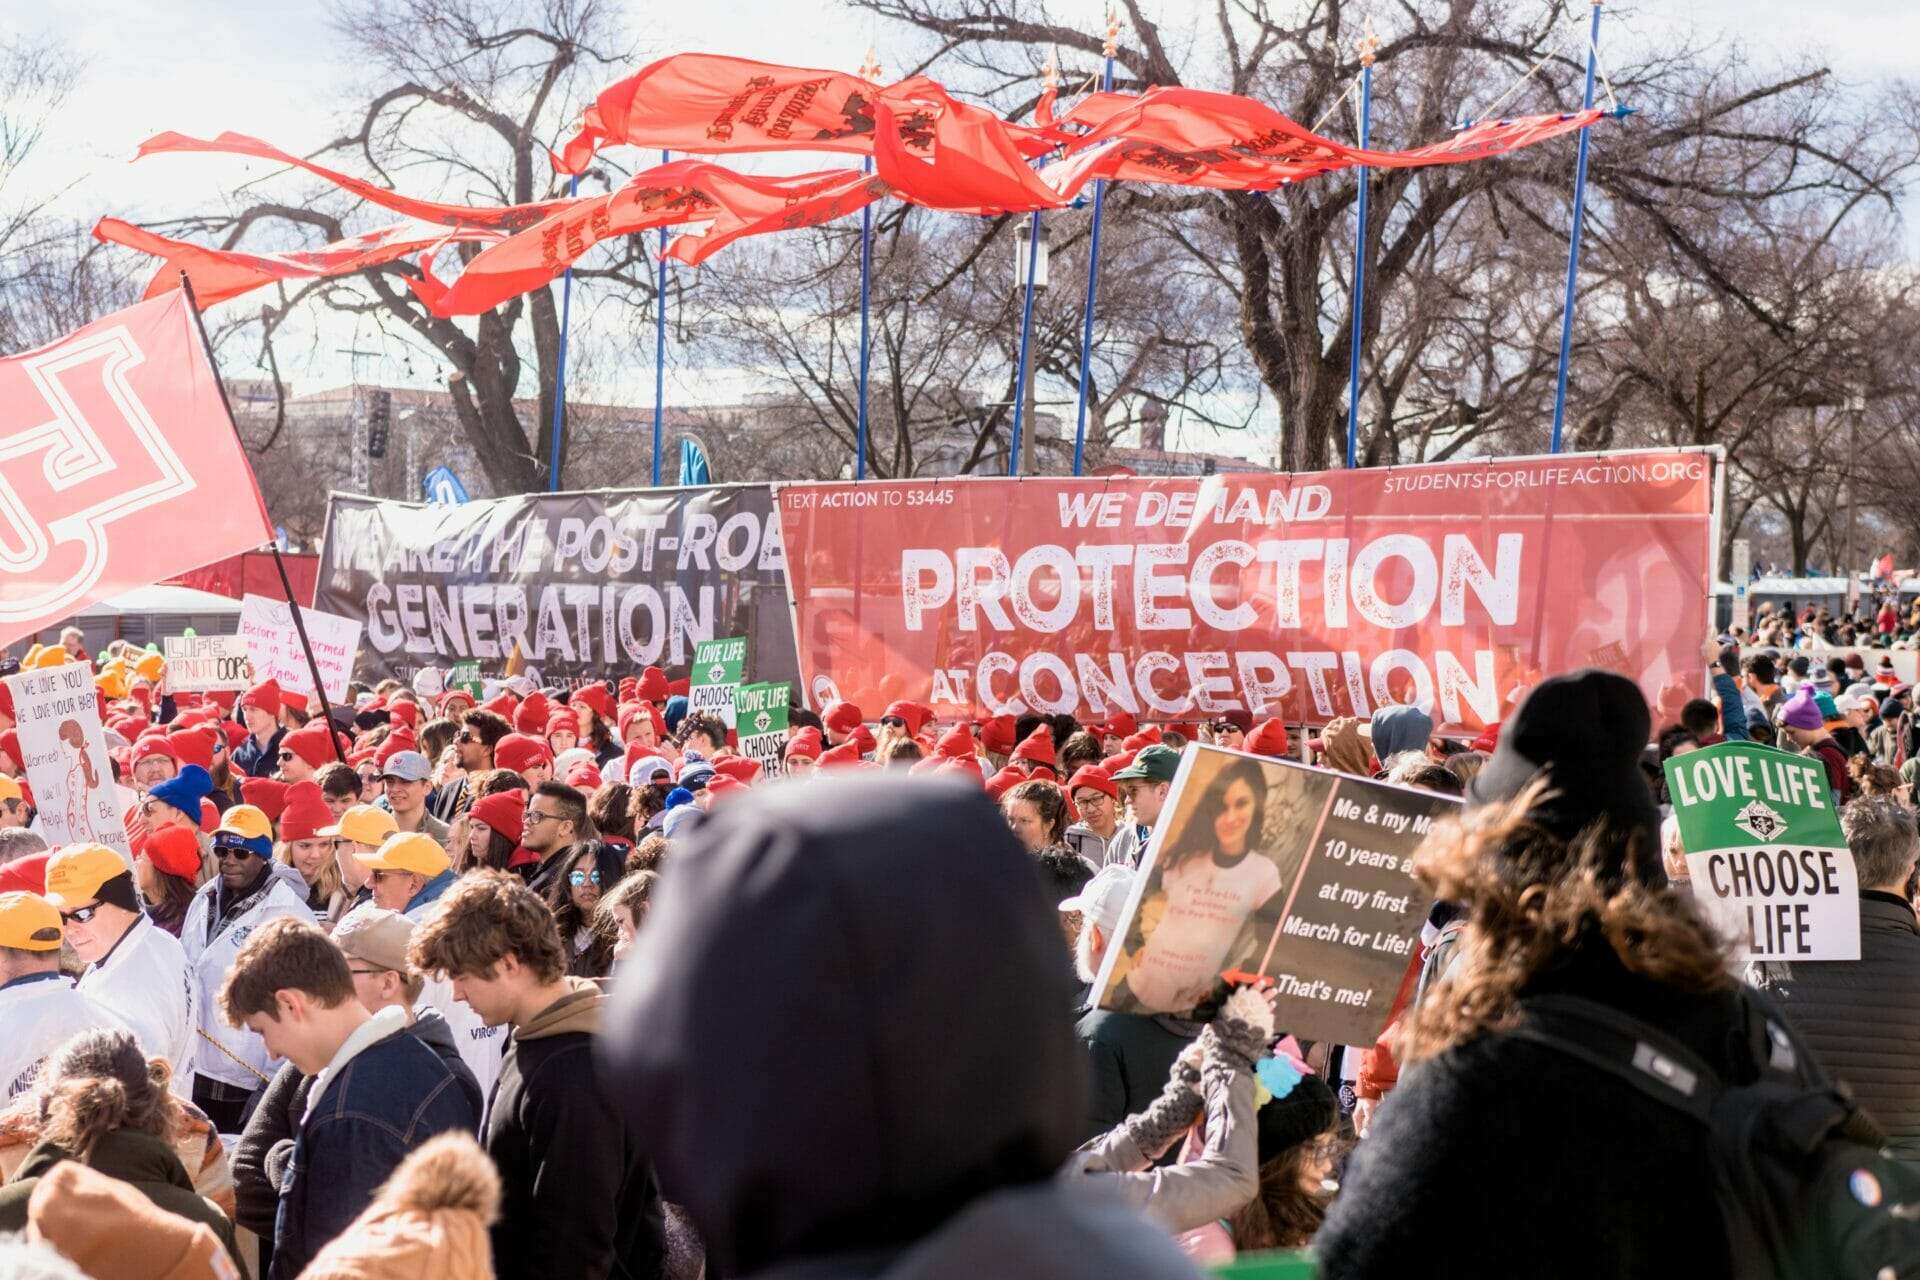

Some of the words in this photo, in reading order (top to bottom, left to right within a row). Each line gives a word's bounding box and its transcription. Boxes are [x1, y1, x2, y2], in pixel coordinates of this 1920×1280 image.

[786, 493, 818, 509] TEXT
[821, 491, 878, 508] ACTION
[882, 490, 902, 506] TO
[906, 489, 954, 506] 53445
[1058, 492, 1126, 527] WE
[902, 532, 1524, 633] PROTECTION
[366, 582, 715, 667] GENERATION
[167, 636, 226, 658] LIFE
[696, 643, 724, 664] LOVE
[722, 640, 745, 662] LIFE
[22, 679, 36, 697] WE
[61, 669, 83, 689] YOU
[217, 655, 250, 681] OOPS
[693, 685, 734, 707] CHOOSE
[767, 686, 789, 709] LIFE
[930, 668, 973, 706] AT
[976, 648, 1500, 726] CONCEPTION
[33, 703, 51, 720] LOVE
[1674, 756, 1758, 807] LOVE
[1759, 758, 1826, 809] LIFE
[98, 801, 114, 819] Be
[1332, 798, 1359, 820] Me
[1363, 803, 1379, 819] &
[1381, 810, 1411, 835] my
[1323, 838, 1346, 860] 10
[1348, 845, 1398, 871] years
[1708, 849, 1840, 898] CHOOSE
[1319, 880, 1341, 901] at
[1343, 887, 1368, 911] my
[1371, 889, 1410, 914] first
[1283, 914, 1340, 943] March
[1342, 924, 1370, 946] for
[1371, 929, 1413, 956] Life!
[1747, 903, 1812, 955] LIFE
[1277, 973, 1332, 1002] That's
[1334, 984, 1373, 1008] me!
